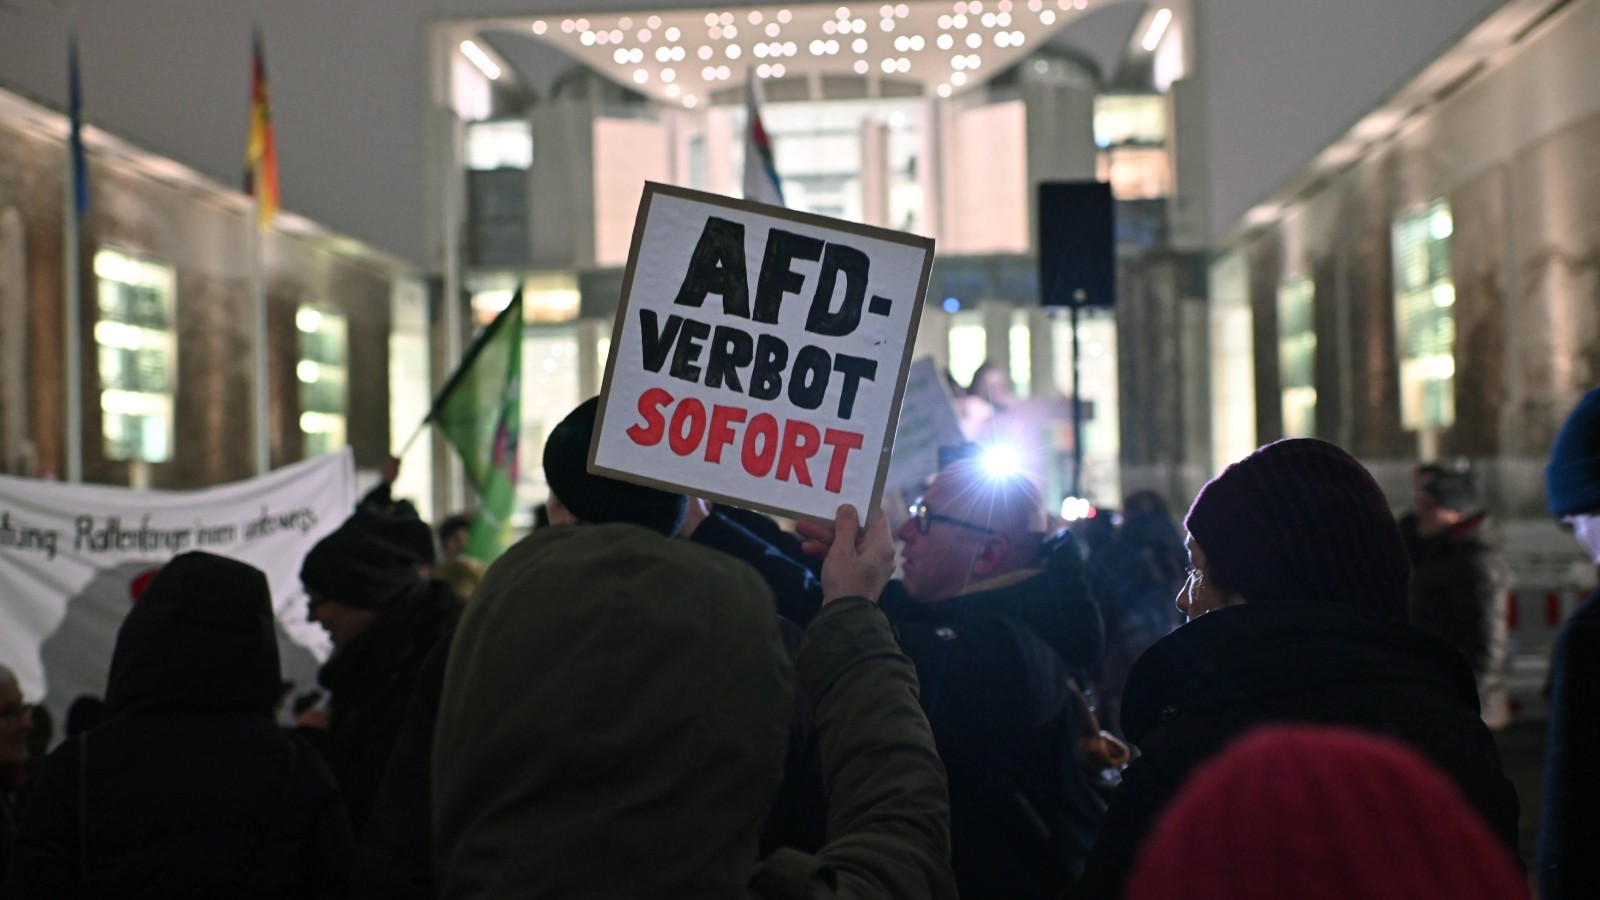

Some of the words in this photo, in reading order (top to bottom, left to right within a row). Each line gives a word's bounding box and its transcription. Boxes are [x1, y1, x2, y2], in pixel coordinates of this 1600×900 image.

[674, 215, 893, 337] AFD-
[639, 308, 879, 421] VERBOT
[625, 387, 865, 495] SOFORT
